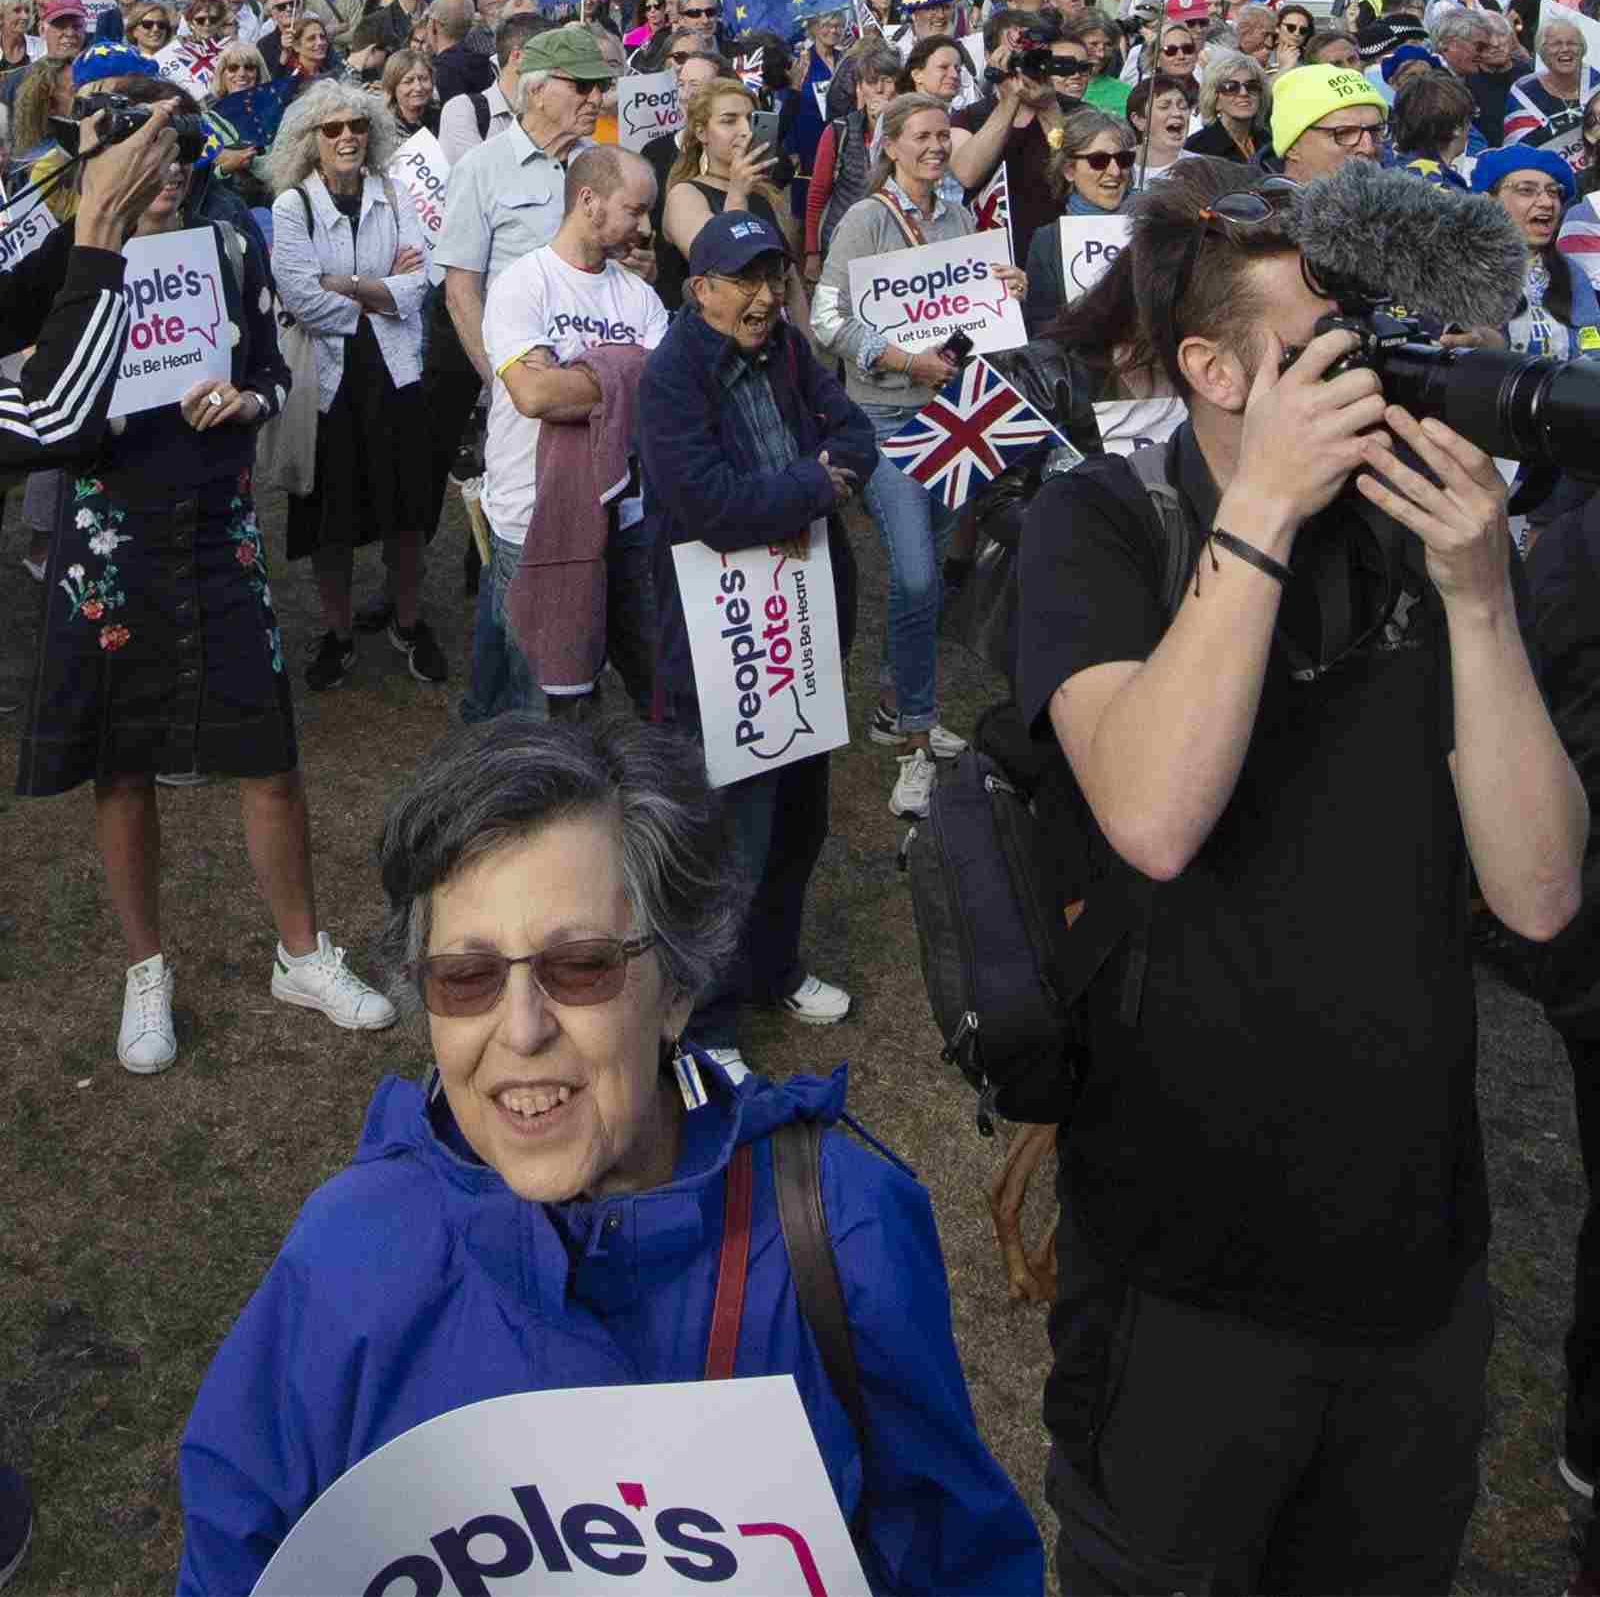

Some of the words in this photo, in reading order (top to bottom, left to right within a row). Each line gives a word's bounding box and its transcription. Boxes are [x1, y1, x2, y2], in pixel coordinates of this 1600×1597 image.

[1333, 84, 1354, 98] TO
[872, 258, 988, 301] People's
[902, 294, 971, 324] Vote
[124, 312, 185, 354] ote
[897, 331, 915, 344] Let
[916, 327, 931, 340] Us
[933, 324, 949, 337] Be
[123, 363, 141, 379] Us
[143, 358, 161, 374] Be
[163, 348, 202, 370] Heard
[791, 569, 809, 623] Heard
[762, 594, 796, 698] Vote
[799, 624, 812, 646] Be
[715, 569, 767, 747] People's
[801, 649, 816, 670] Us
[804, 672, 816, 697] Let
